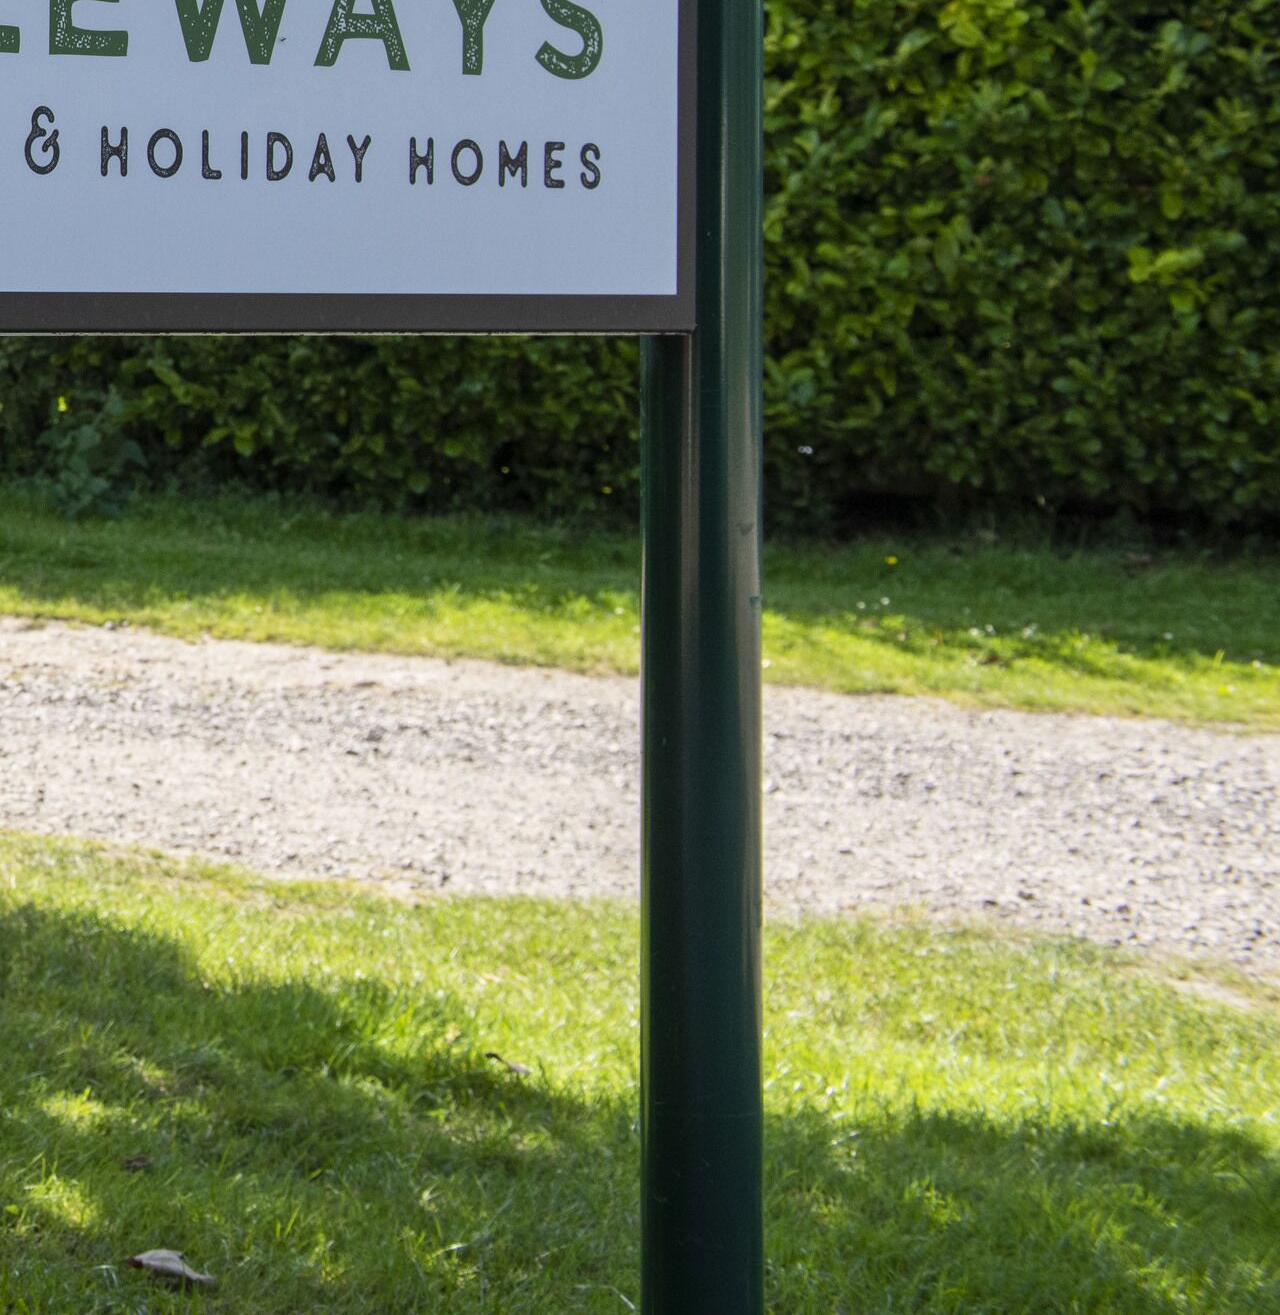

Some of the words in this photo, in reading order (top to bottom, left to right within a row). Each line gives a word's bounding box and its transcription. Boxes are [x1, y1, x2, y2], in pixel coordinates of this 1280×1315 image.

[24, 106, 60, 175] &
[100, 125, 371, 183] HOLIDAY
[409, 137, 601, 190] HOMES
